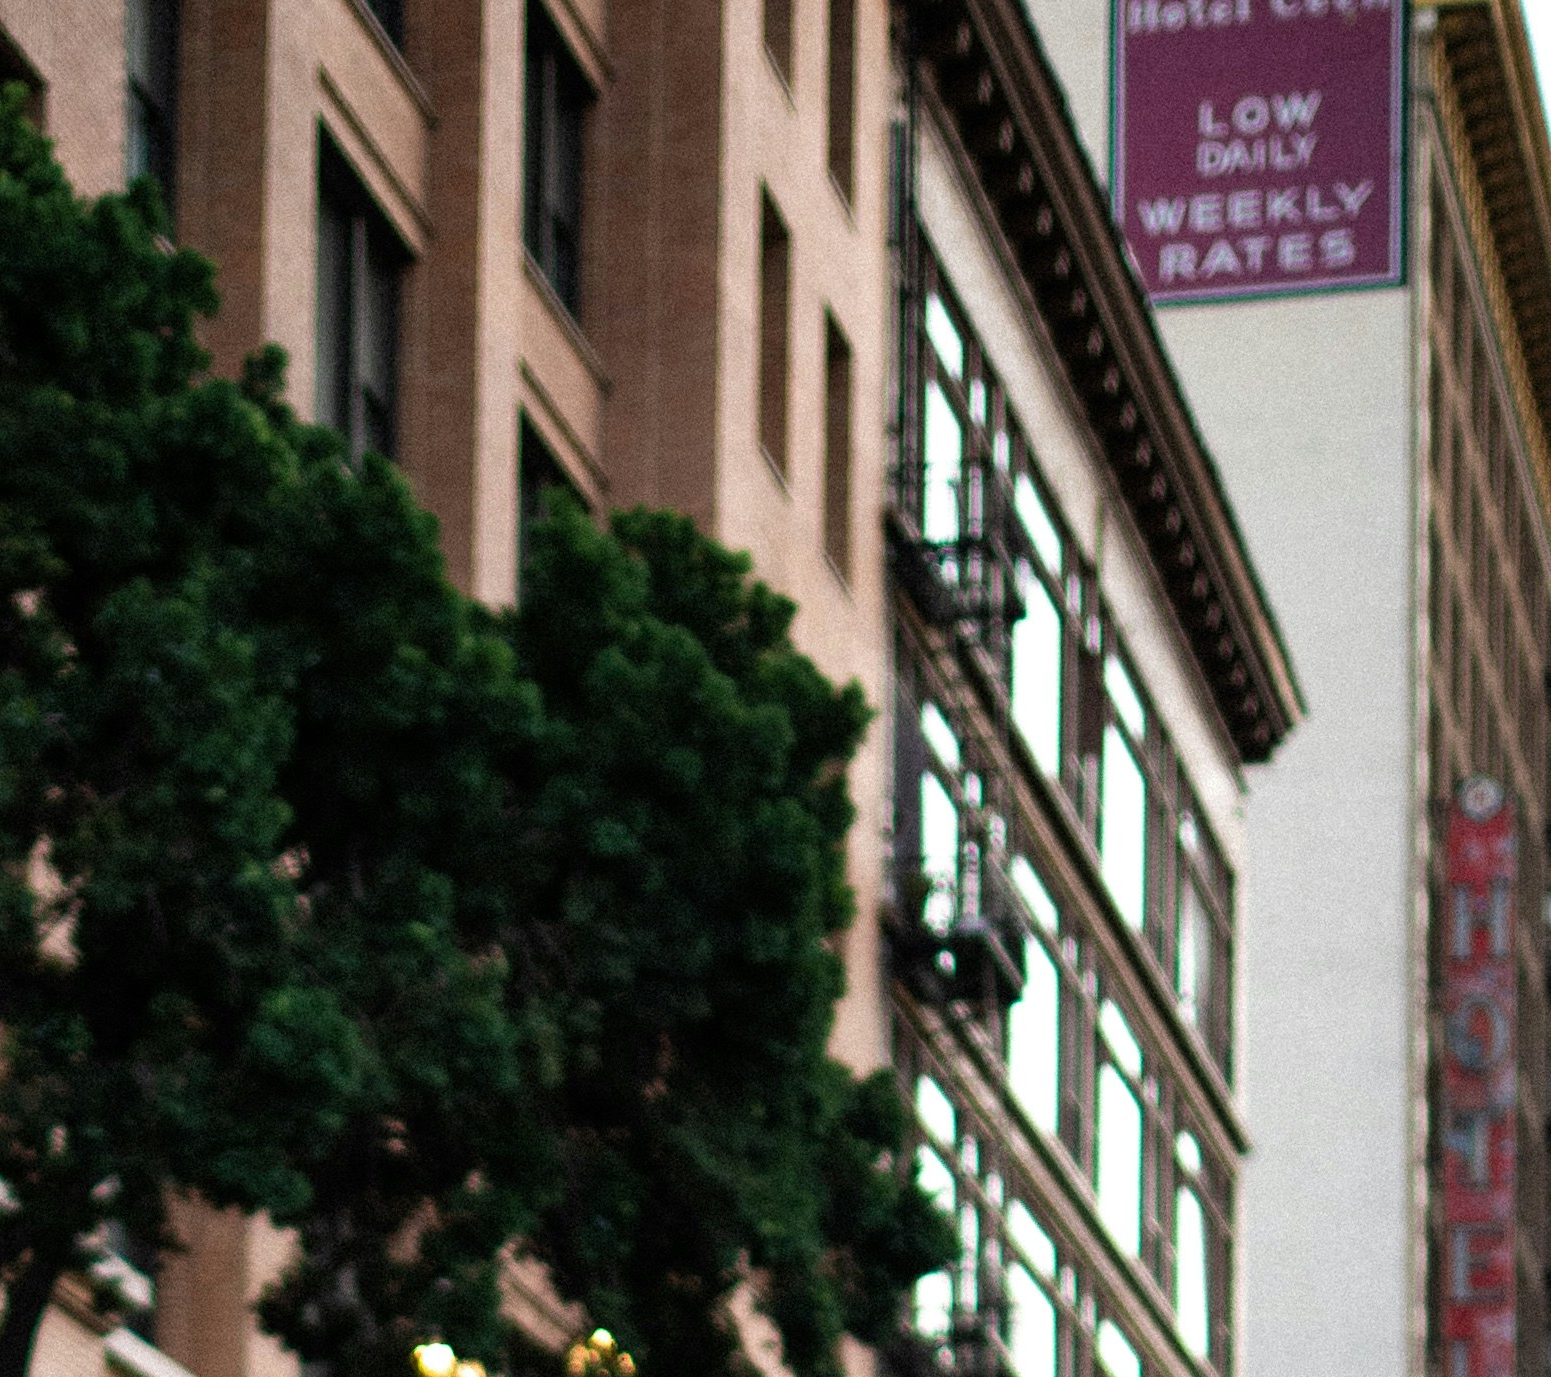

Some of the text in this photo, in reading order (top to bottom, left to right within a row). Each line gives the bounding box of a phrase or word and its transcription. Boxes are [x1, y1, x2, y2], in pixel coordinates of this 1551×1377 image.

[1199, 92, 1321, 137] LOW
[1198, 133, 1314, 177] DAILY
[1139, 181, 1373, 235] WEEKLY
[1159, 230, 1355, 282] RATES
